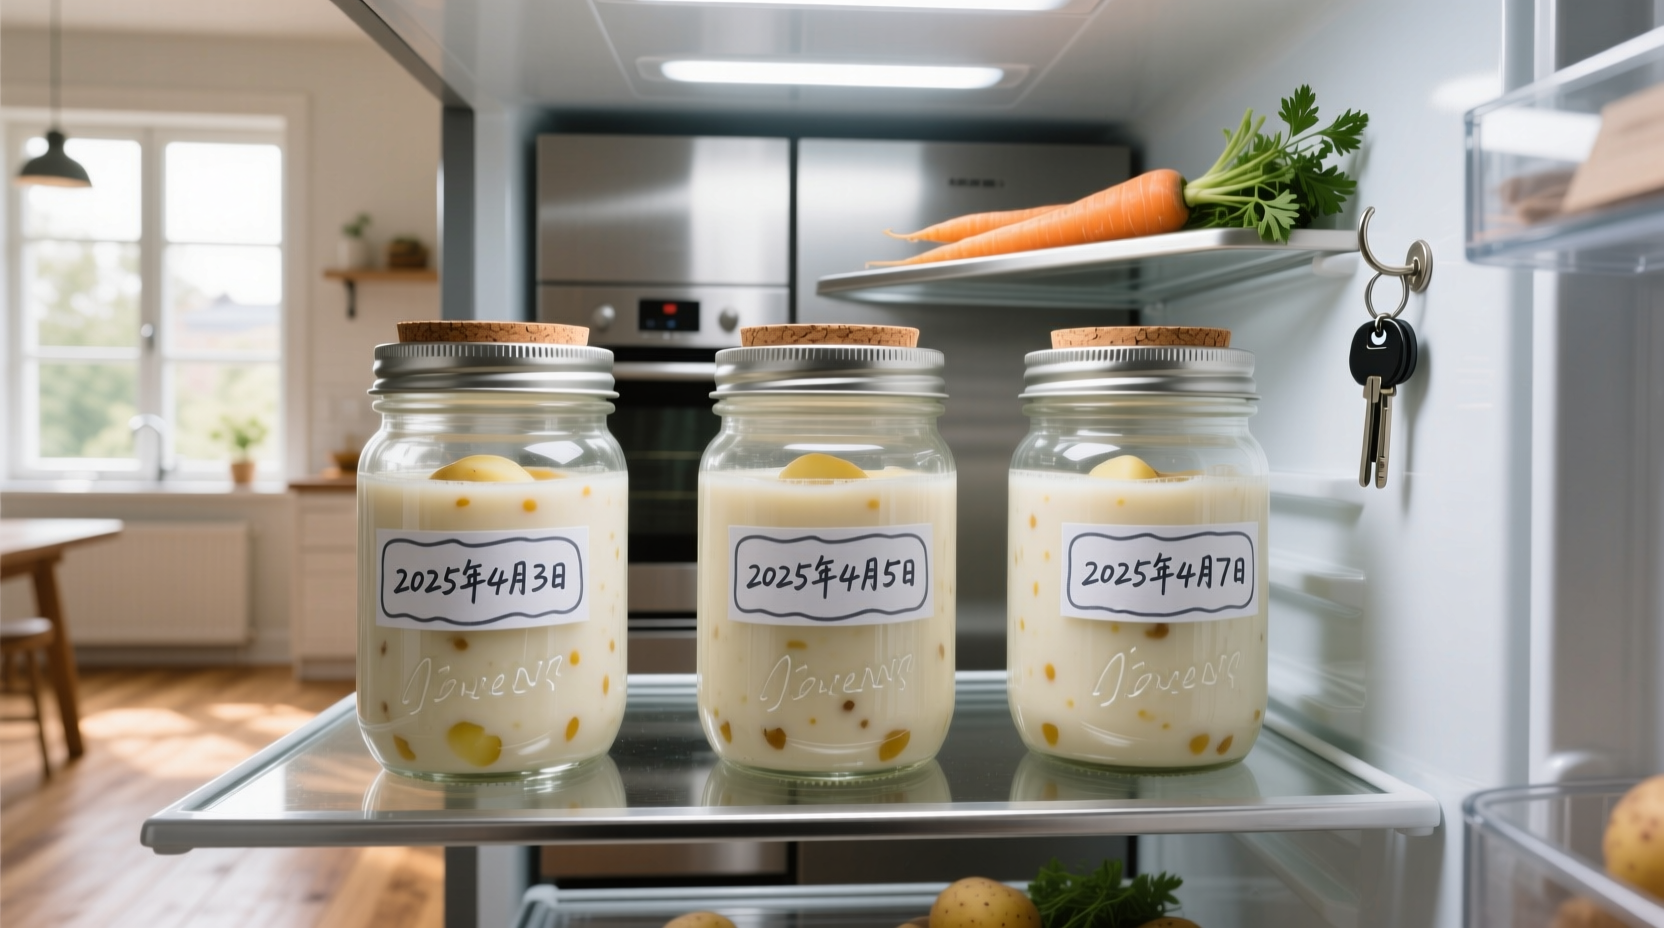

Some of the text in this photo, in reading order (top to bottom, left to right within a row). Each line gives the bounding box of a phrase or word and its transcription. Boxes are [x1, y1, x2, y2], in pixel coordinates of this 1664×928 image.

[393, 558, 566, 605] 2025年4月3日
[746, 555, 915, 600] 2025年4月5日
[1081, 552, 1246, 596] 2025年4月7日
